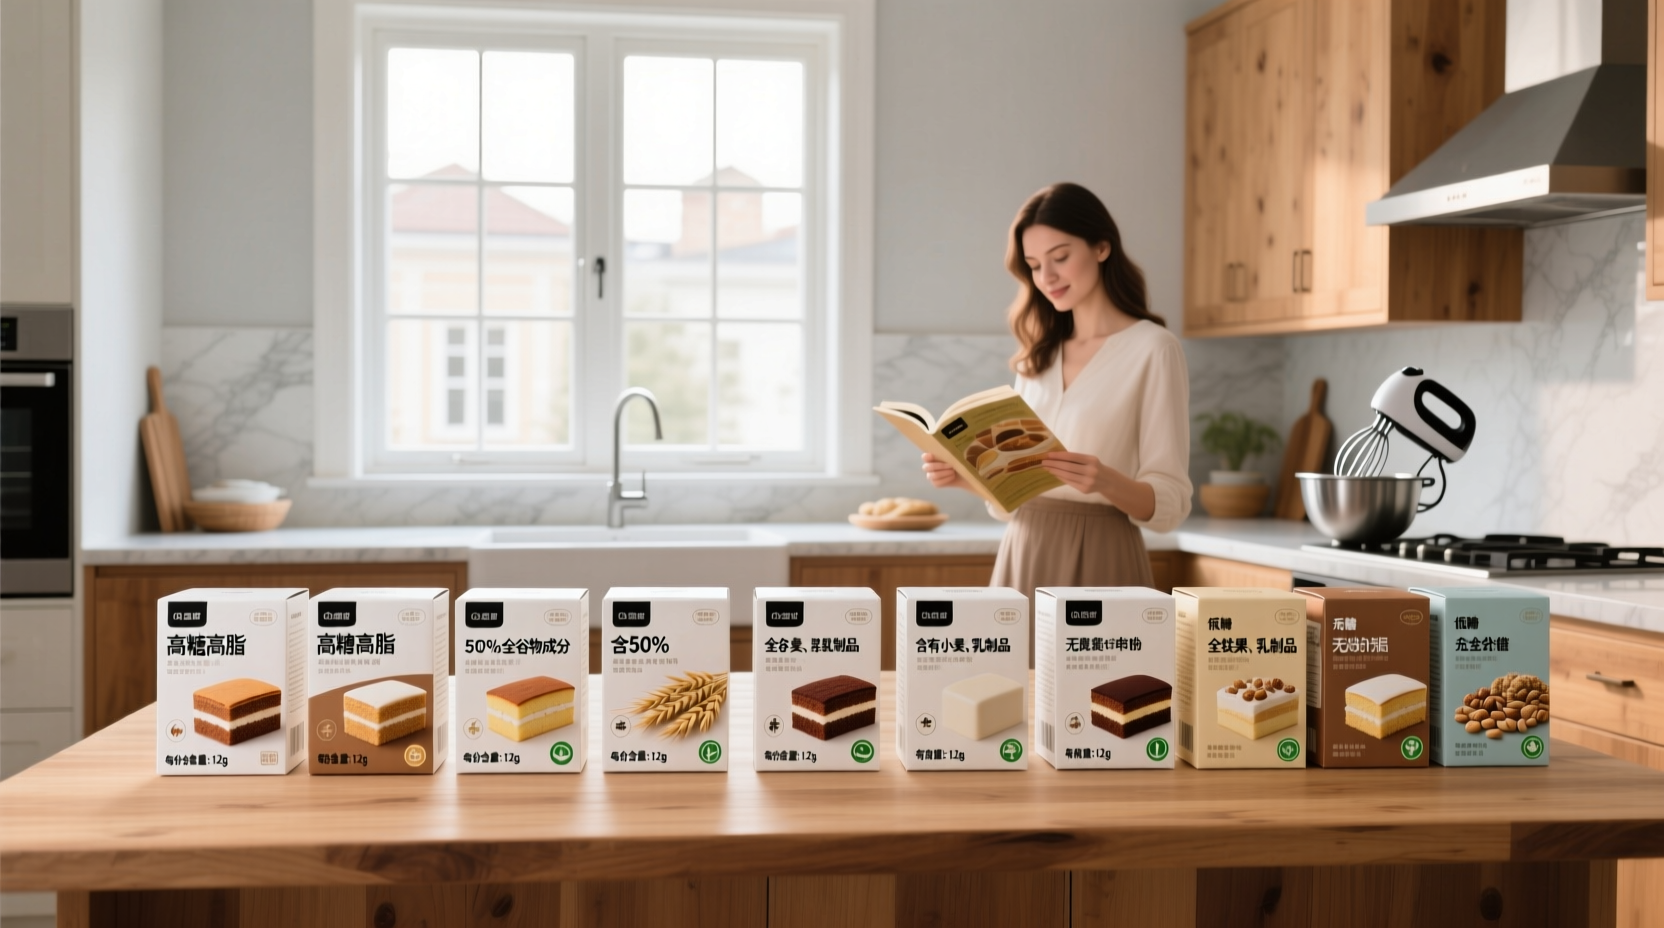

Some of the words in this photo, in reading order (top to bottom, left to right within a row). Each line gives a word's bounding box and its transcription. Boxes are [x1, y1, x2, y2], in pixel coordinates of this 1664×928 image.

[167, 634, 246, 656] 高糖高脂
[317, 633, 395, 655] 高糖高脂
[465, 638, 570, 654] 50%全谷物成分
[611, 635, 669, 654] 含50%
